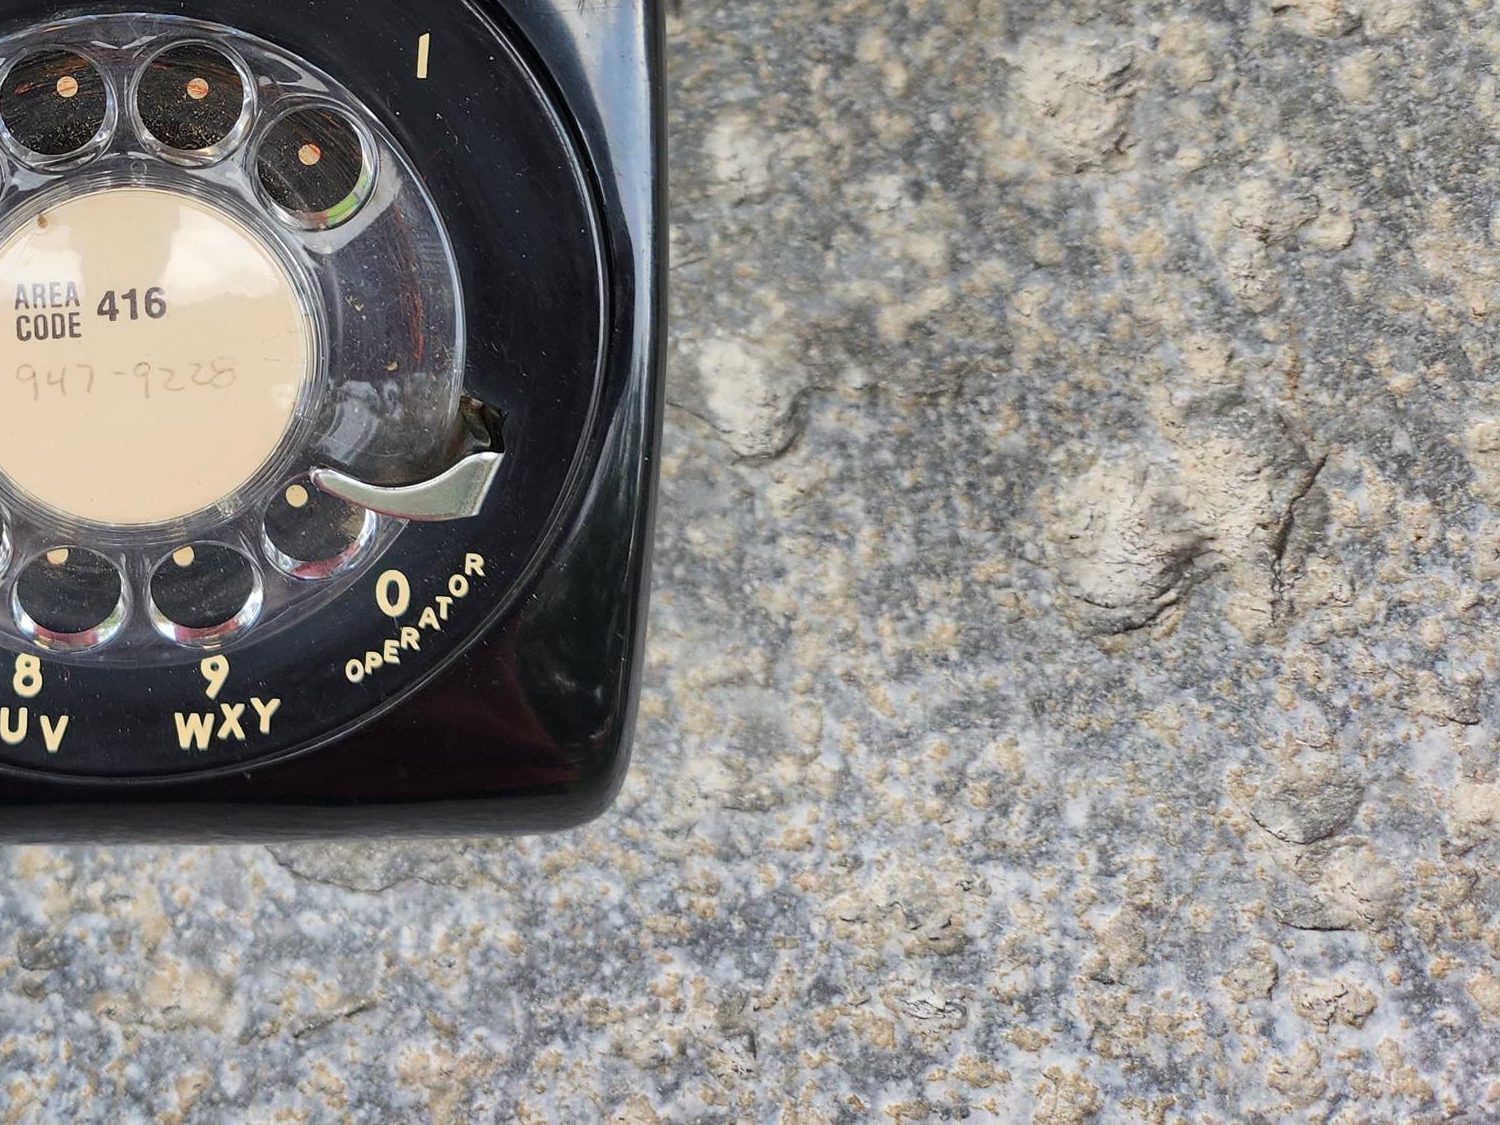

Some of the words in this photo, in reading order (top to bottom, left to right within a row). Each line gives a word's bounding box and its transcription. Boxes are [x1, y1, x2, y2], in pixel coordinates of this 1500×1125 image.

[14, 280, 81, 311] AREA
[96, 286, 168, 323] 416
[15, 312, 83, 342] CODE
[345, 552, 485, 681] OPERATOR
[12, 652, 43, 697] 8
[200, 654, 229, 698] 9
[174, 697, 281, 749] WXY
